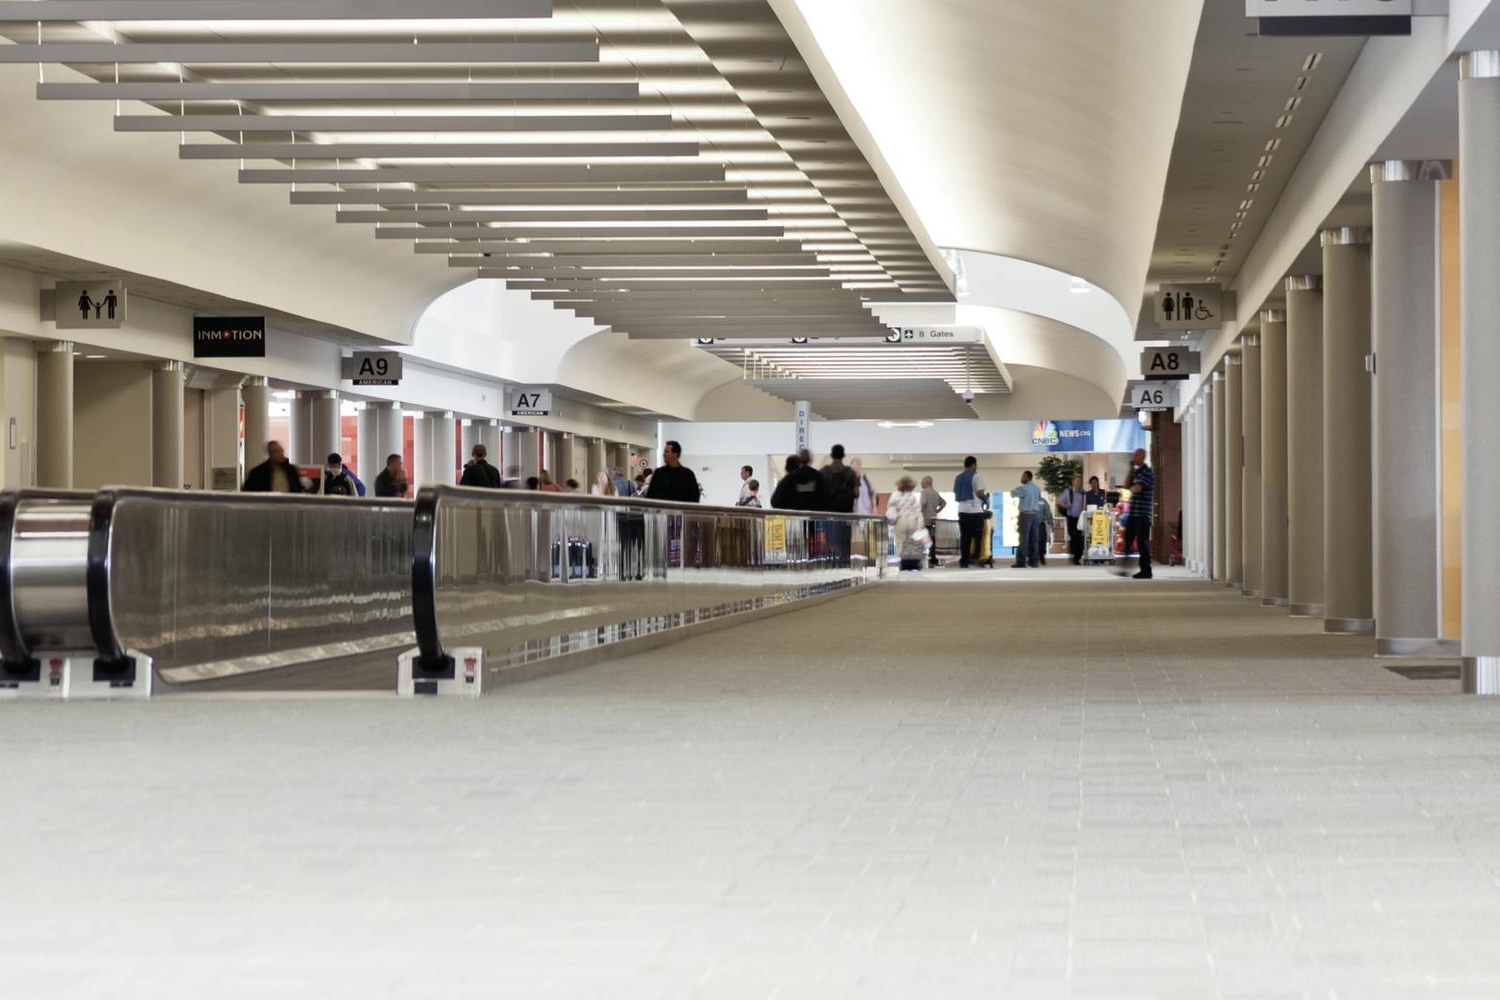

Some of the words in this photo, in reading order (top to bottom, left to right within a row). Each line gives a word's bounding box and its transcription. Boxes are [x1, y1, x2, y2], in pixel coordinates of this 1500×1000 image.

[930, 330, 954, 338] Gates
[359, 357, 389, 376] A9
[1150, 352, 1180, 371] A8
[517, 393, 541, 408] A7
[1140, 389, 1164, 405] A6
